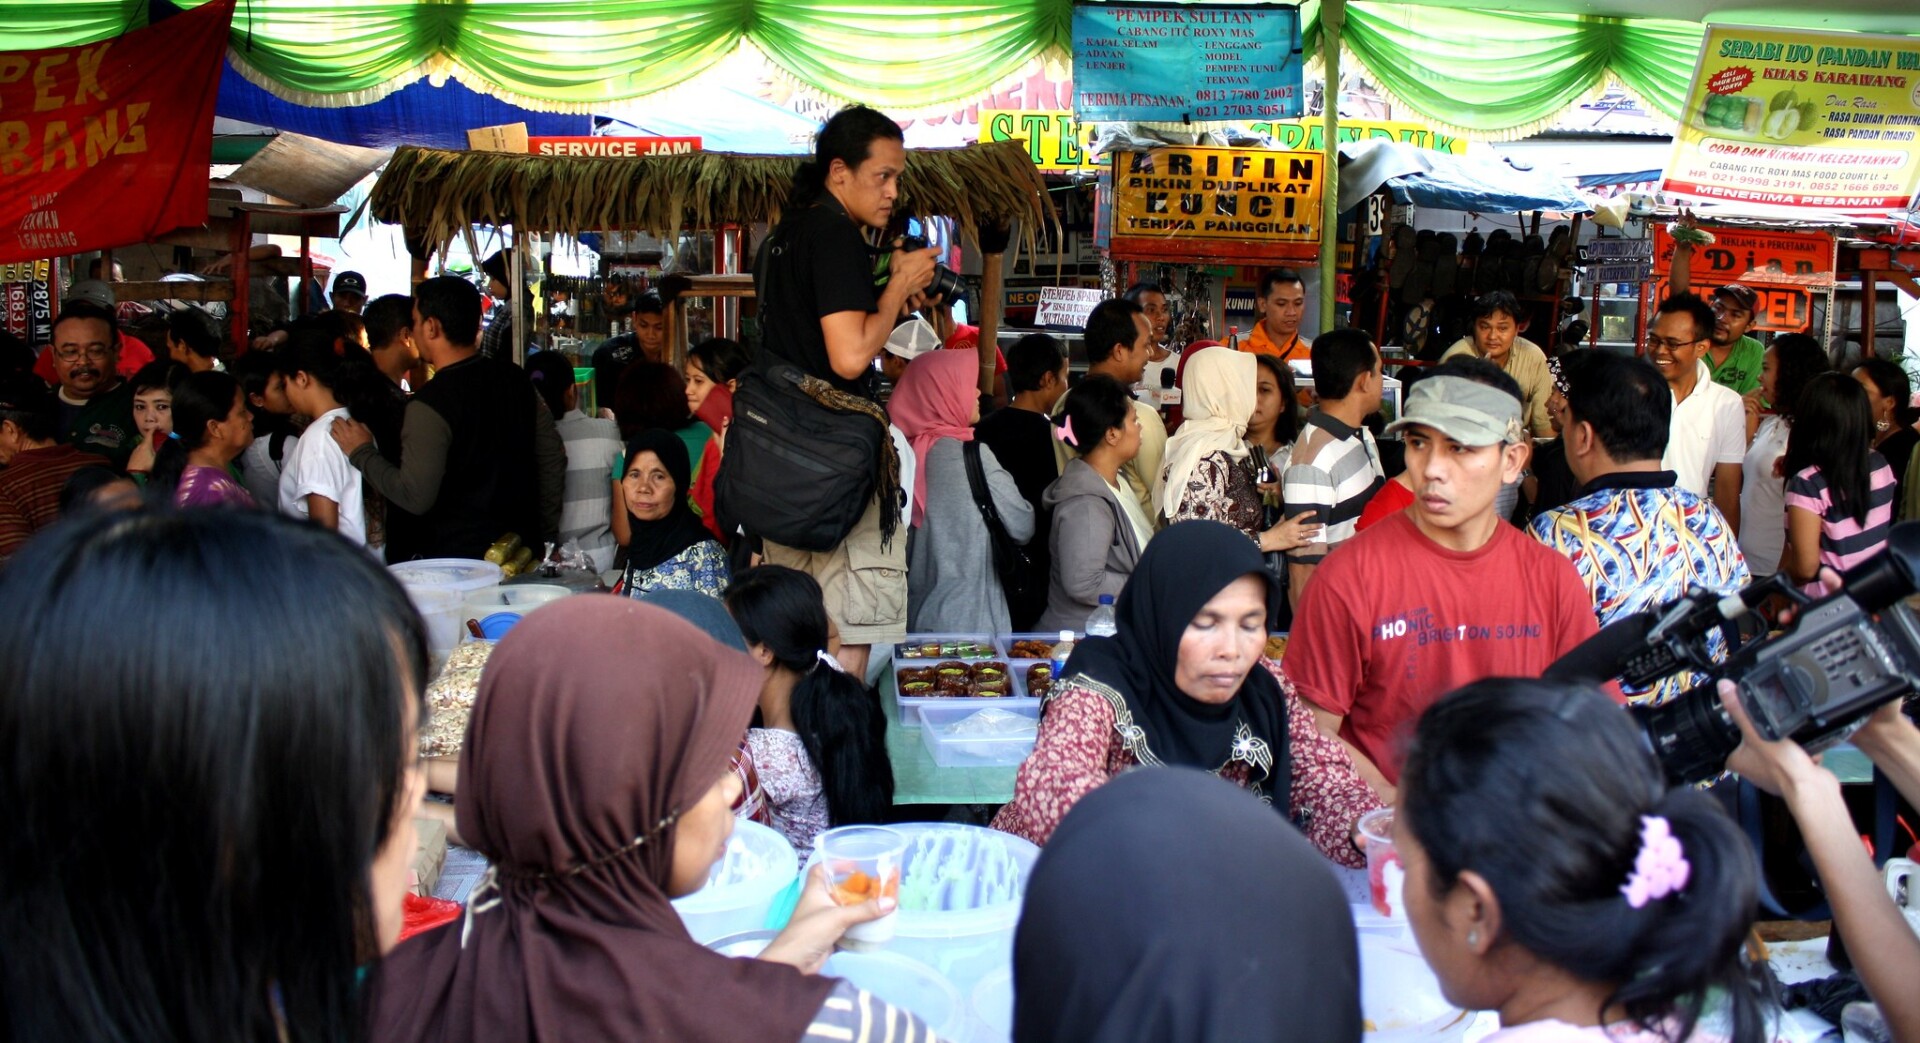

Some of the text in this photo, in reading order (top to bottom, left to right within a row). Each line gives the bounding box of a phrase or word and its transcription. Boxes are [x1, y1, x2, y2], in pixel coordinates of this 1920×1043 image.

[1118, 26, 1255, 37] CABANG ITC ROXY MAS
[1086, 38, 1158, 48] KAPAL SELAM
[1205, 42, 1262, 50] LENGGANG
[1205, 53, 1242, 61] MODEL
[1719, 39, 1785, 62] SERABI
[1785, 44, 1814, 64] IJO
[1817, 46, 1892, 67] (PANDAN
[1086, 62, 1126, 70] LENJER
[1205, 65, 1278, 73] PEMPEN TUNU
[1206, 76, 1250, 84] TEKWAN
[1721, 70, 1737, 79] ASLI
[1762, 67, 1907, 89] KHAS KARAWANG
[1080, 92, 1185, 108] TERIMA PESANAN
[1196, 86, 1294, 101] 0813 7780 2002
[1825, 94, 1878, 109] Dua Rasa
[1196, 104, 1286, 117] 021 2703 5051
[1828, 112, 1851, 123] RASA
[1852, 113, 1885, 125] DURIAN
[1823, 128, 1915, 141] RASA PANDAN (MANIS)
[539, 141, 692, 158] SERVICE JAM
[1709, 143, 1902, 166] COBA DAN NIKMATI KELEZATANNYA
[1129, 152, 1313, 181] ARIFIN
[1710, 161, 1747, 173] CABANG
[1750, 166, 1765, 175] ITC
[1767, 168, 1789, 177] ROXI
[1791, 169, 1811, 179] MAS
[1813, 171, 1837, 180] FOOD
[1839, 172, 1868, 181] COURT
[1129, 177, 1311, 194] BIKIN DUPLIKAT
[1712, 173, 1770, 187] 021-9998
[1809, 182, 1839, 191] 0852
[1843, 183, 1869, 191] 1666
[1872, 184, 1900, 192] 6926
[1695, 185, 1885, 207] MENERIMA PESANAN
[1146, 192, 1295, 218] KUNCI
[1128, 217, 1311, 234] TERIMA PANGGILAN
[18, 231, 78, 250] LENGGANG
[1721, 237, 1817, 252] REKLAME & PERCETAKAN
[1704, 249, 1815, 276] Dian
[33, 281, 50, 319] 2875
[1042, 288, 1076, 302] STEMPEL
[11, 285, 26, 322] 1683
[1225, 297, 1256, 311] KUNIN
[1372, 614, 1434, 641] PHONIC
[1418, 624, 1541, 646] BRIGTON SOUND
